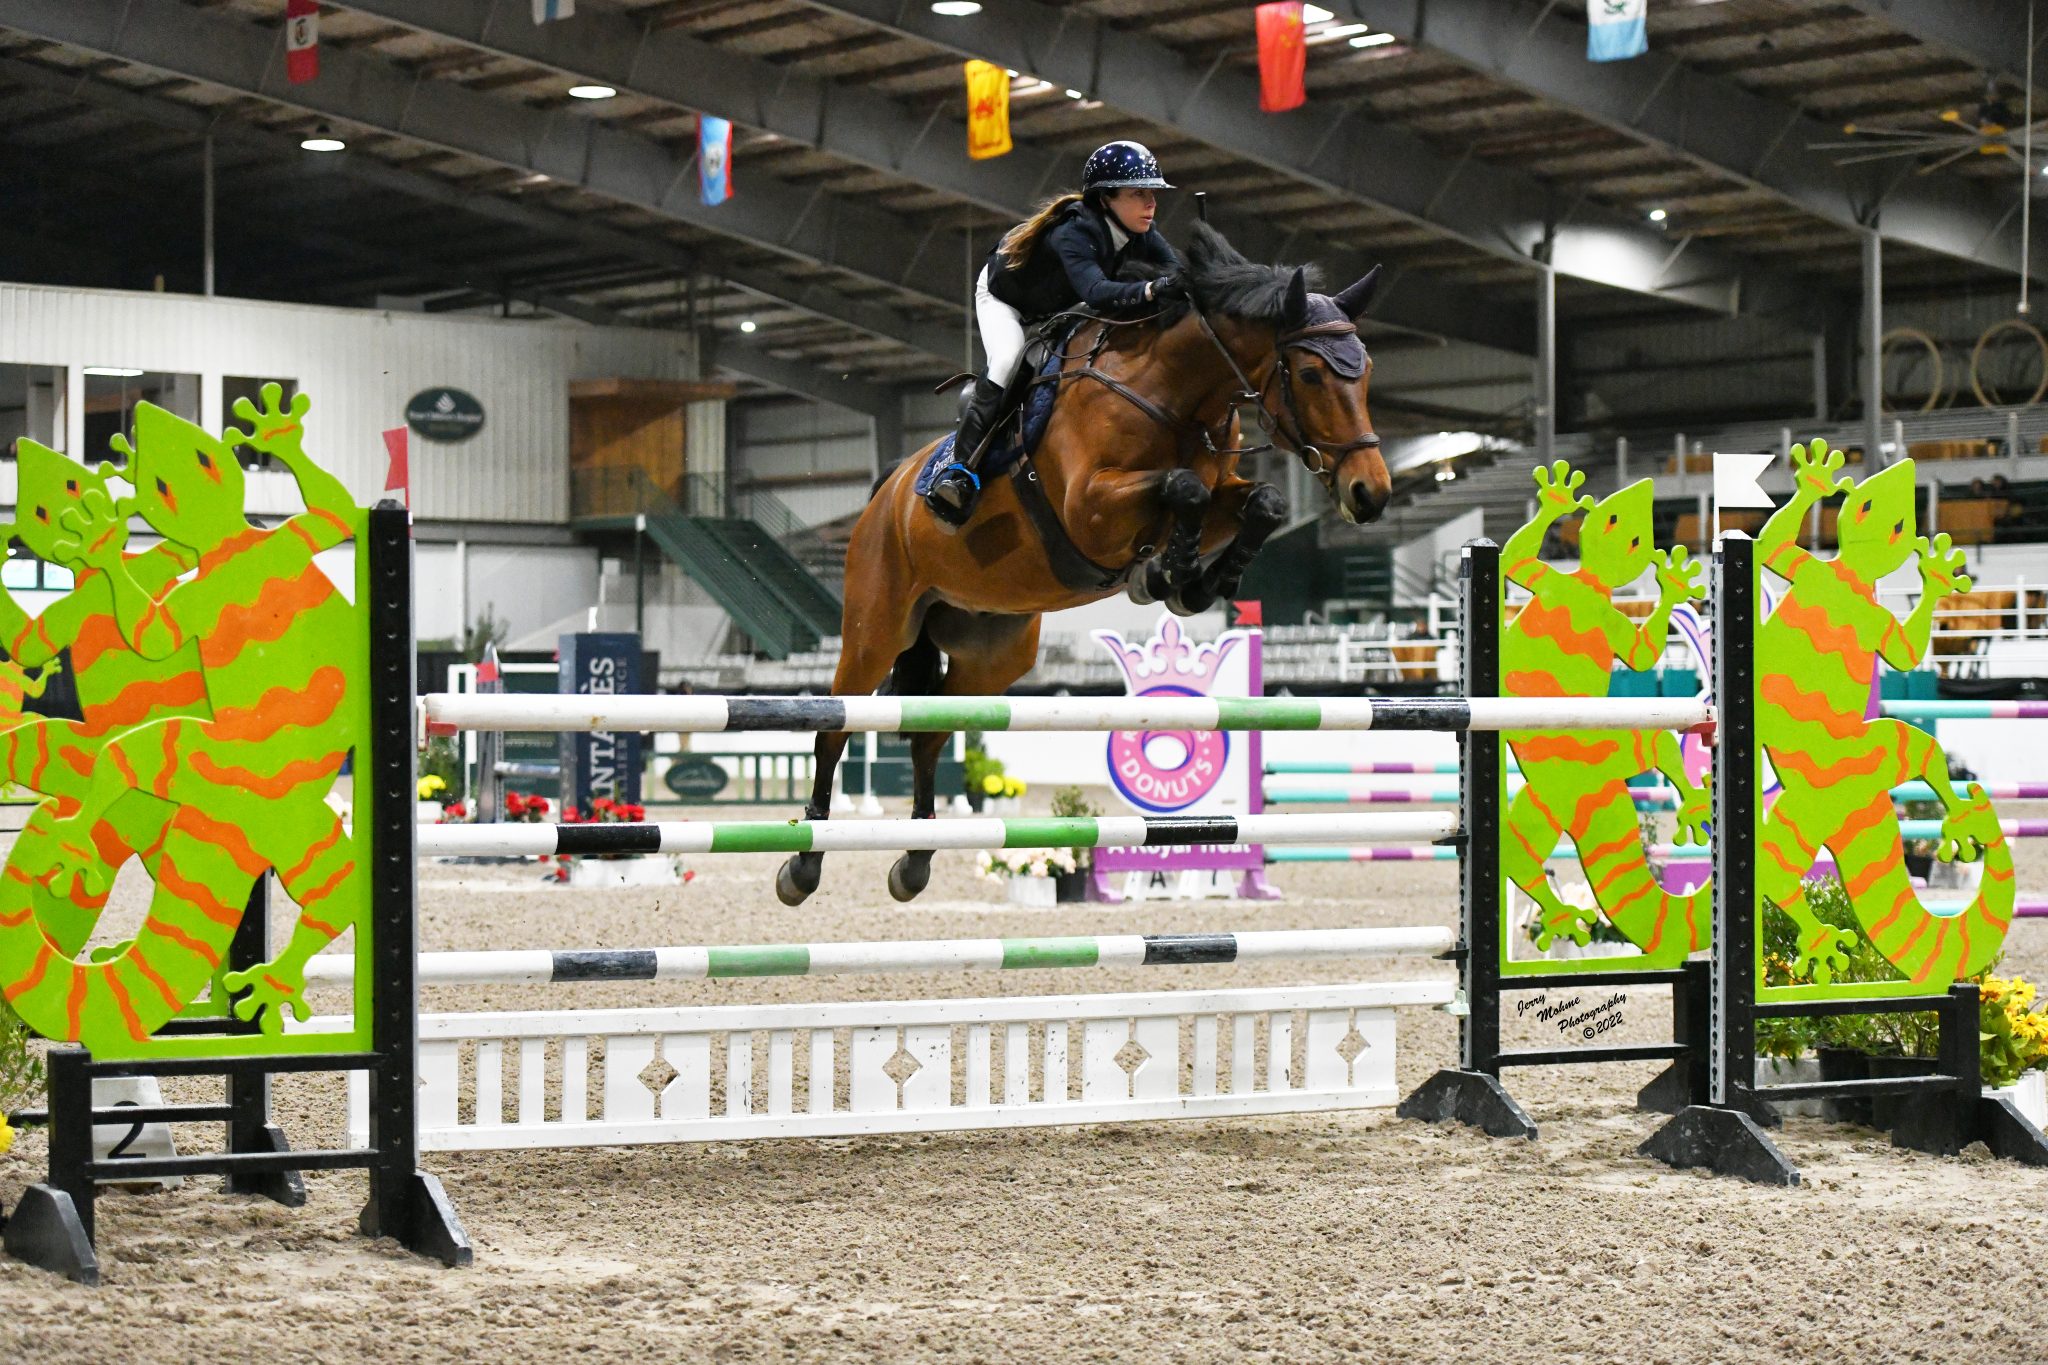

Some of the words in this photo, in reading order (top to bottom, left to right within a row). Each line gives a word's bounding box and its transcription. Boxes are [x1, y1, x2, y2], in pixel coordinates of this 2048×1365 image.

[580, 656, 615, 801] NTAÈS
[1121, 758, 1213, 800] DONUTS
[107, 1100, 147, 1160] 2
